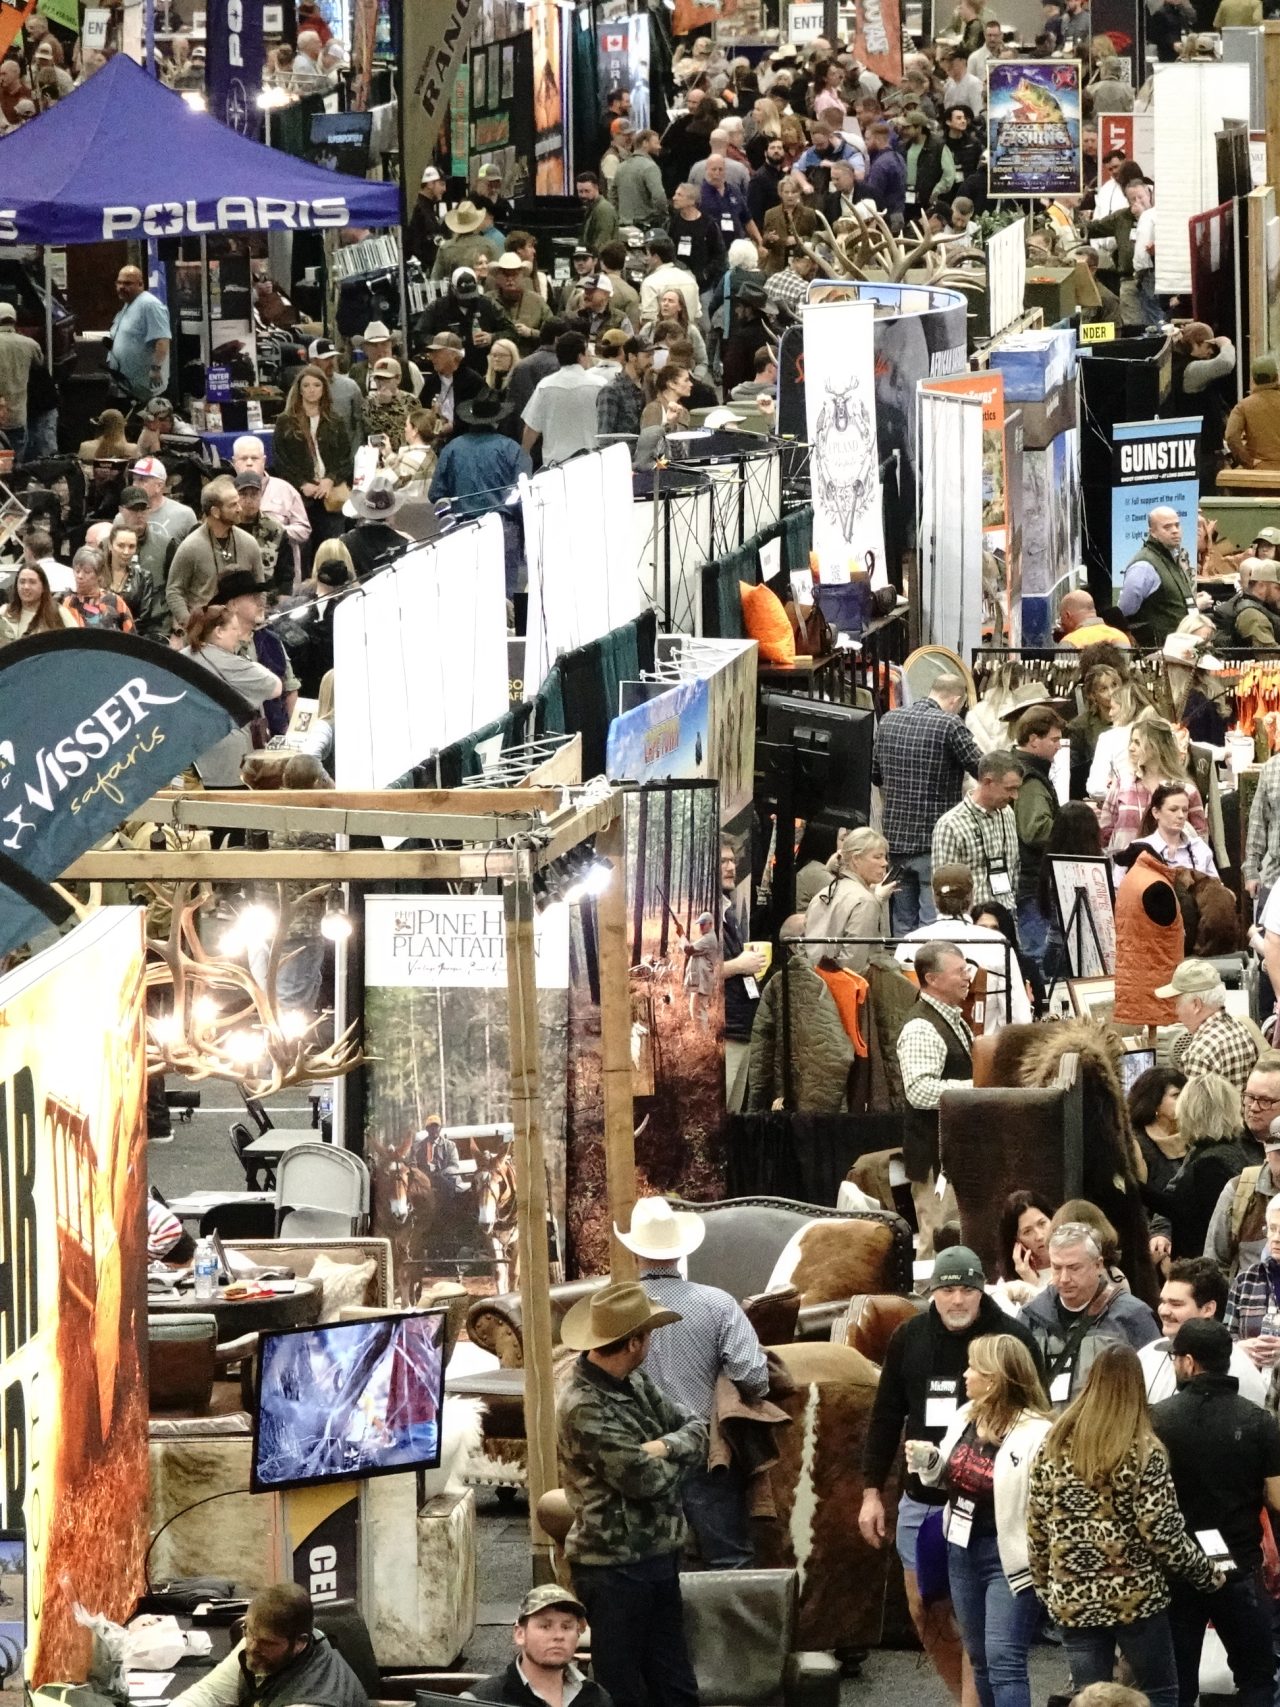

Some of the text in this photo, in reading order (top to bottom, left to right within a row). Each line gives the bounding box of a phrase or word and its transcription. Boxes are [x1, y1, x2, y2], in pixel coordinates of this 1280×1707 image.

[103, 196, 350, 240] POLARIS
[208, 373, 229, 381] ENTER
[1121, 439, 1196, 473] GUNSTIX
[25, 677, 187, 812] VISSER
[71, 726, 165, 815] safaris
[417, 909, 477, 935] PINE
